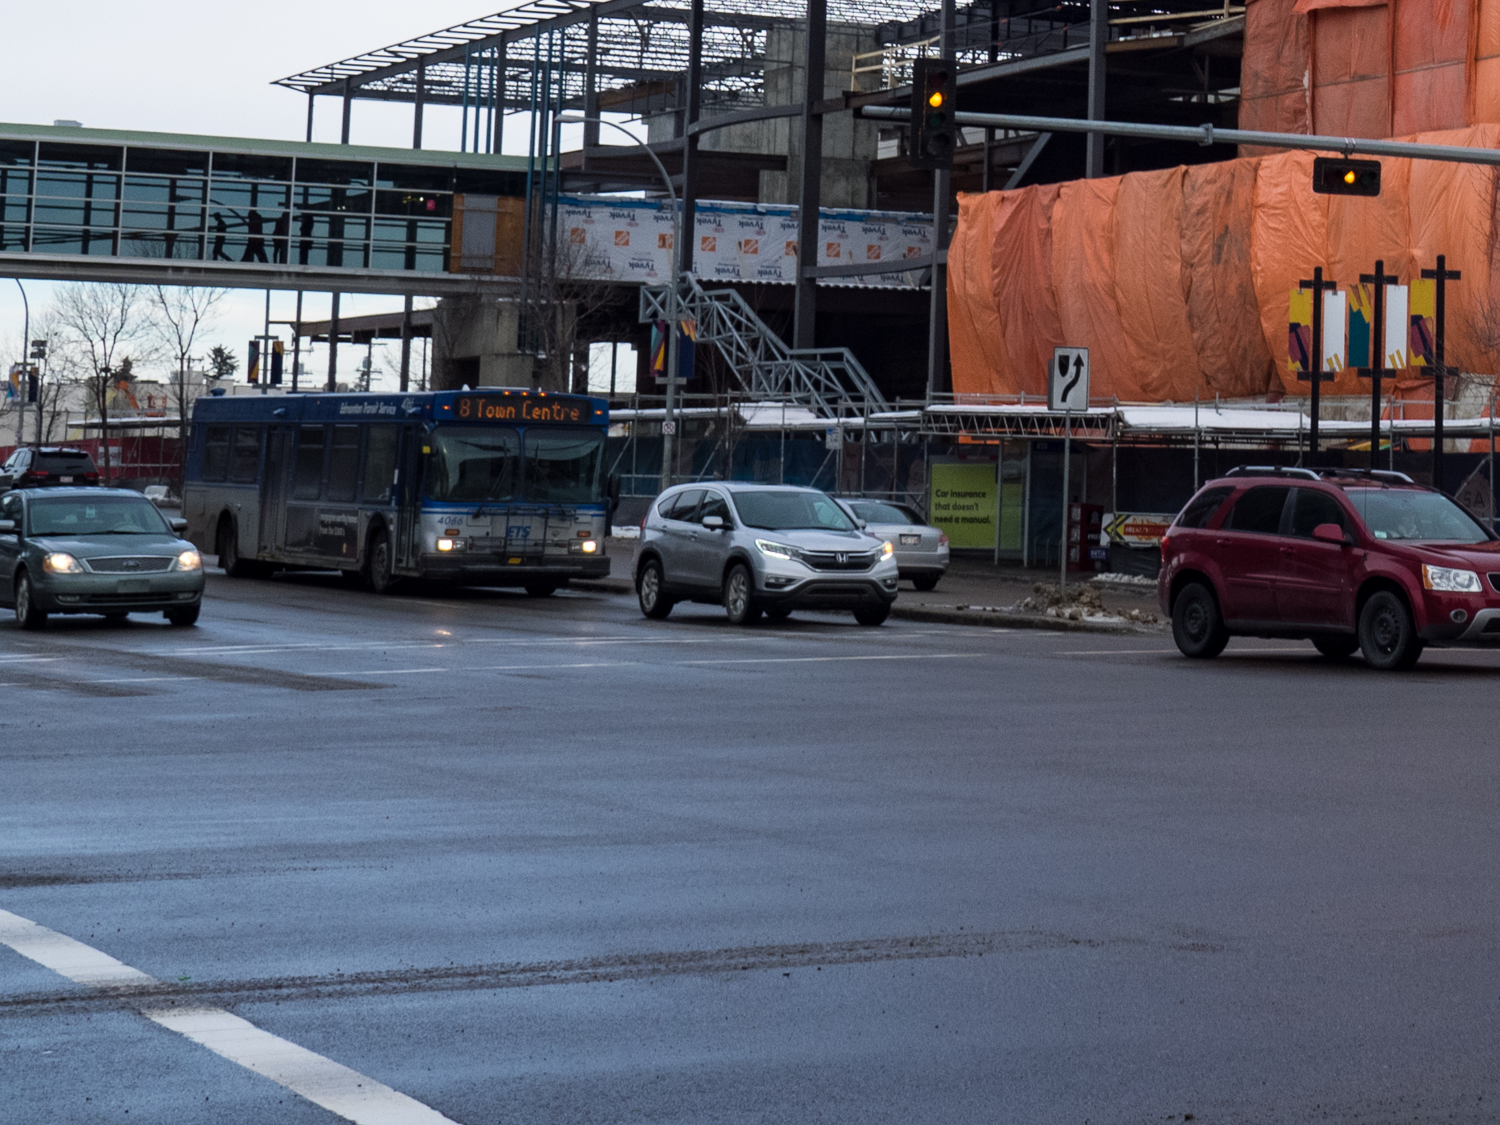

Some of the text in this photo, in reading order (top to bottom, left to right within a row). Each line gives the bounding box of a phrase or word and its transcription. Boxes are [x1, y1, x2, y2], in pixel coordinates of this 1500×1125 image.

[609, 211, 636, 221] Tyvek
[653, 214, 675, 223] yvek
[696, 217, 722, 227] Tyvek
[739, 220, 764, 230] Tyvek
[821, 224, 846, 233] Tyvek
[862, 226, 886, 235] Tyvek
[902, 228, 926, 237] Tyvek
[628, 261, 655, 271] Tyvek
[715, 266, 740, 276] Tyvek
[757, 269, 783, 278] Tyvek
[459, 399, 580, 421] 8 Town Centre
[935, 489, 987, 499] Car insurance
[935, 501, 979, 511] that doesn't
[438, 515, 463, 526] 4066
[934, 514, 953, 524] need
[961, 515, 991, 525] manual.
[508, 525, 531, 538] ETS
